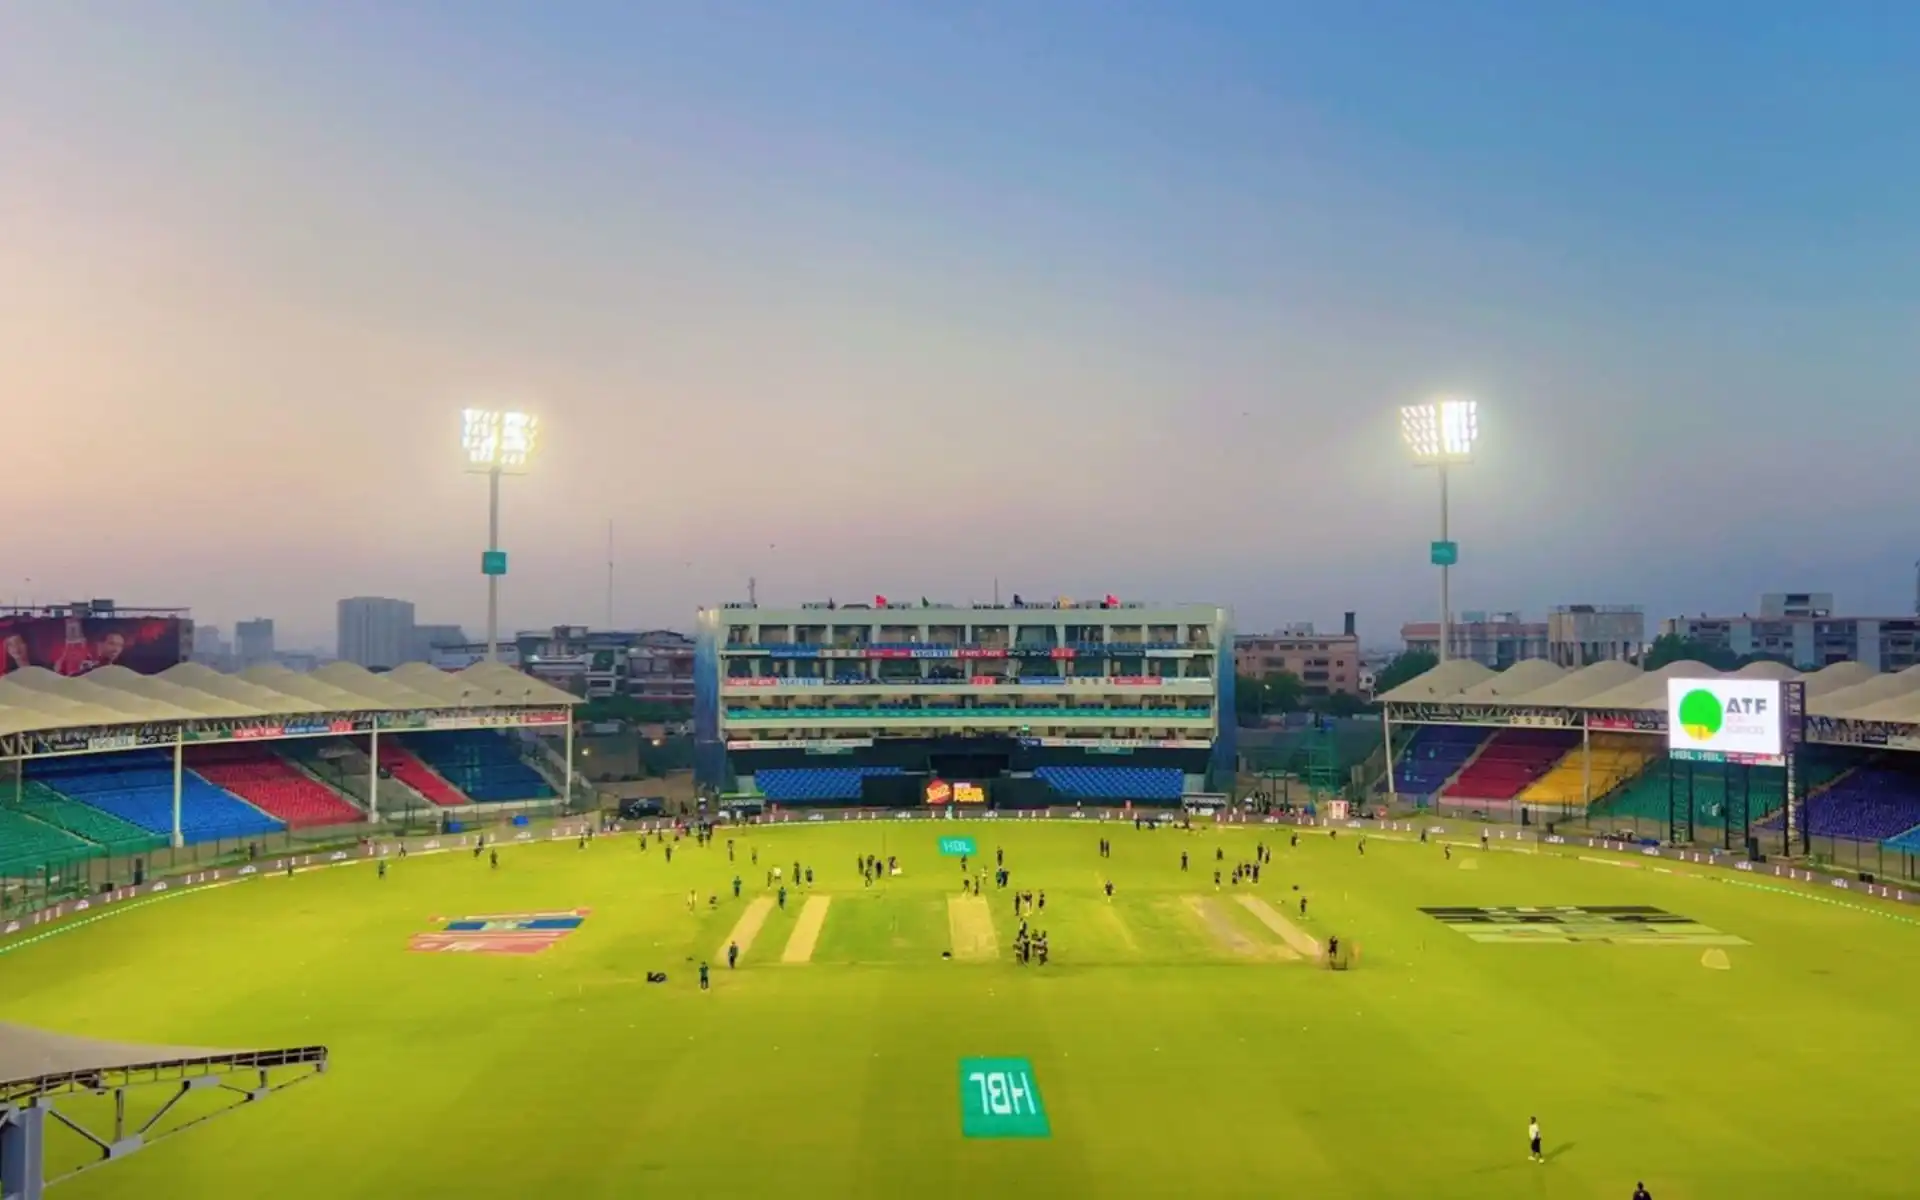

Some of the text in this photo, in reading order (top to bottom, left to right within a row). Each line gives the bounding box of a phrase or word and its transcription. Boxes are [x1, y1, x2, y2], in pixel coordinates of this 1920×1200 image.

[1725, 697, 1767, 714] ATF
[1669, 749, 1695, 760] HBL
[1697, 751, 1724, 762] HBL
[943, 839, 971, 853] HBL
[969, 1072, 1036, 1115] HBL
